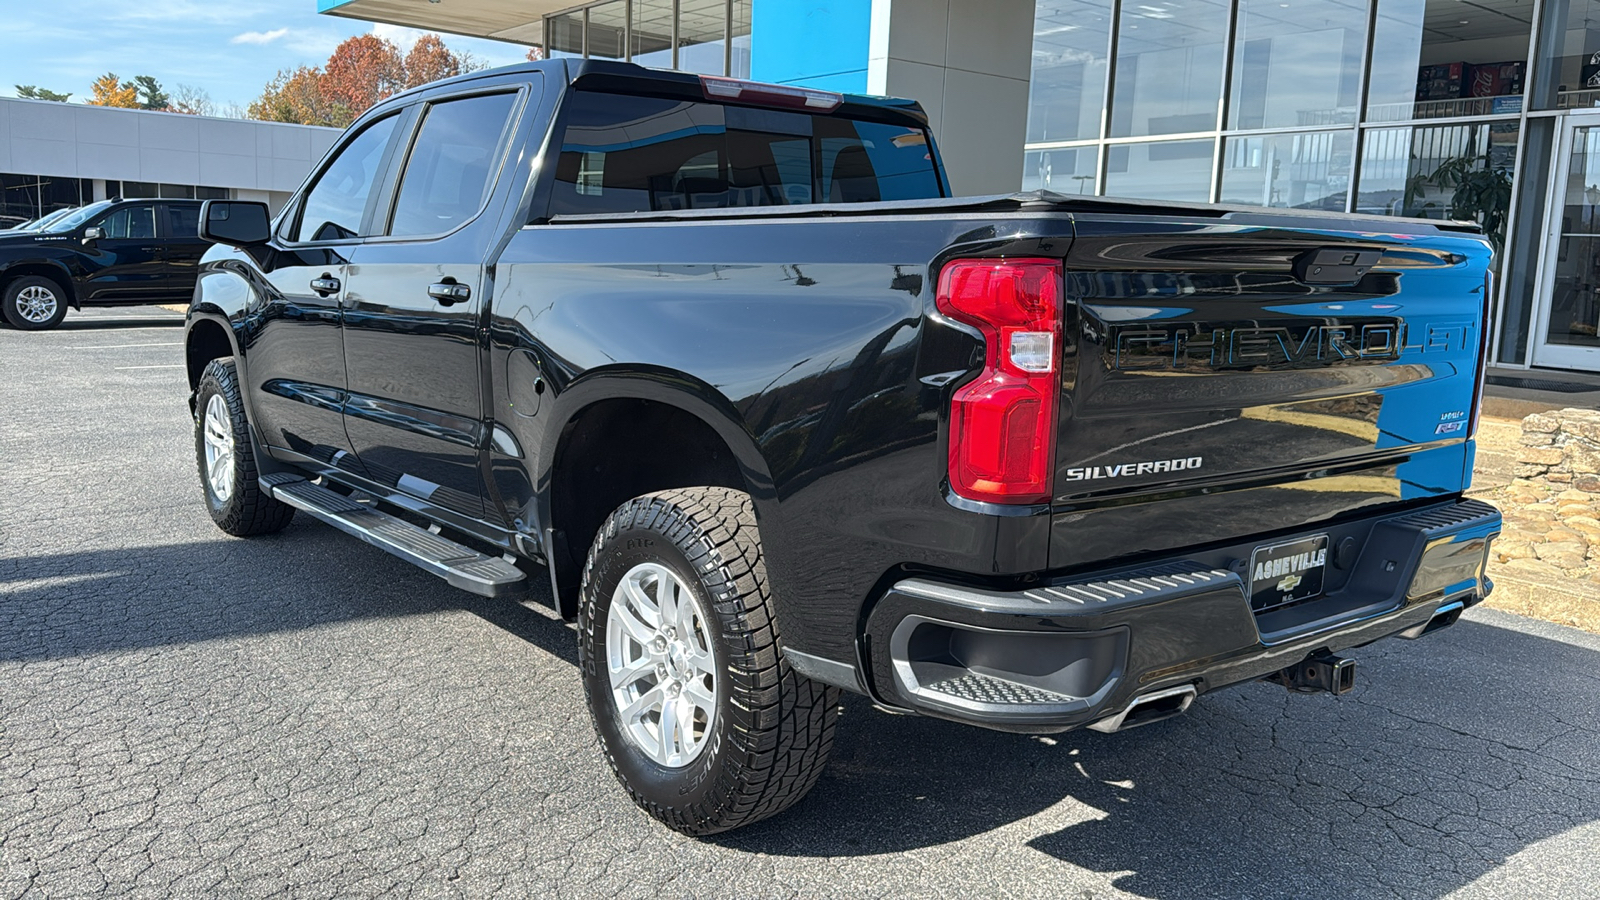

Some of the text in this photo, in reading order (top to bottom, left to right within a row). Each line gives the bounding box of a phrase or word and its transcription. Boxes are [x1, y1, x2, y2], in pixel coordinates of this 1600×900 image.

[1116, 320, 1475, 371] CHEVROLET
[1434, 420, 1468, 435] RST
[1066, 456, 1202, 481] SILVERADO
[1253, 548, 1327, 581] ASHEVILLE
[679, 714, 724, 796] COOPER
